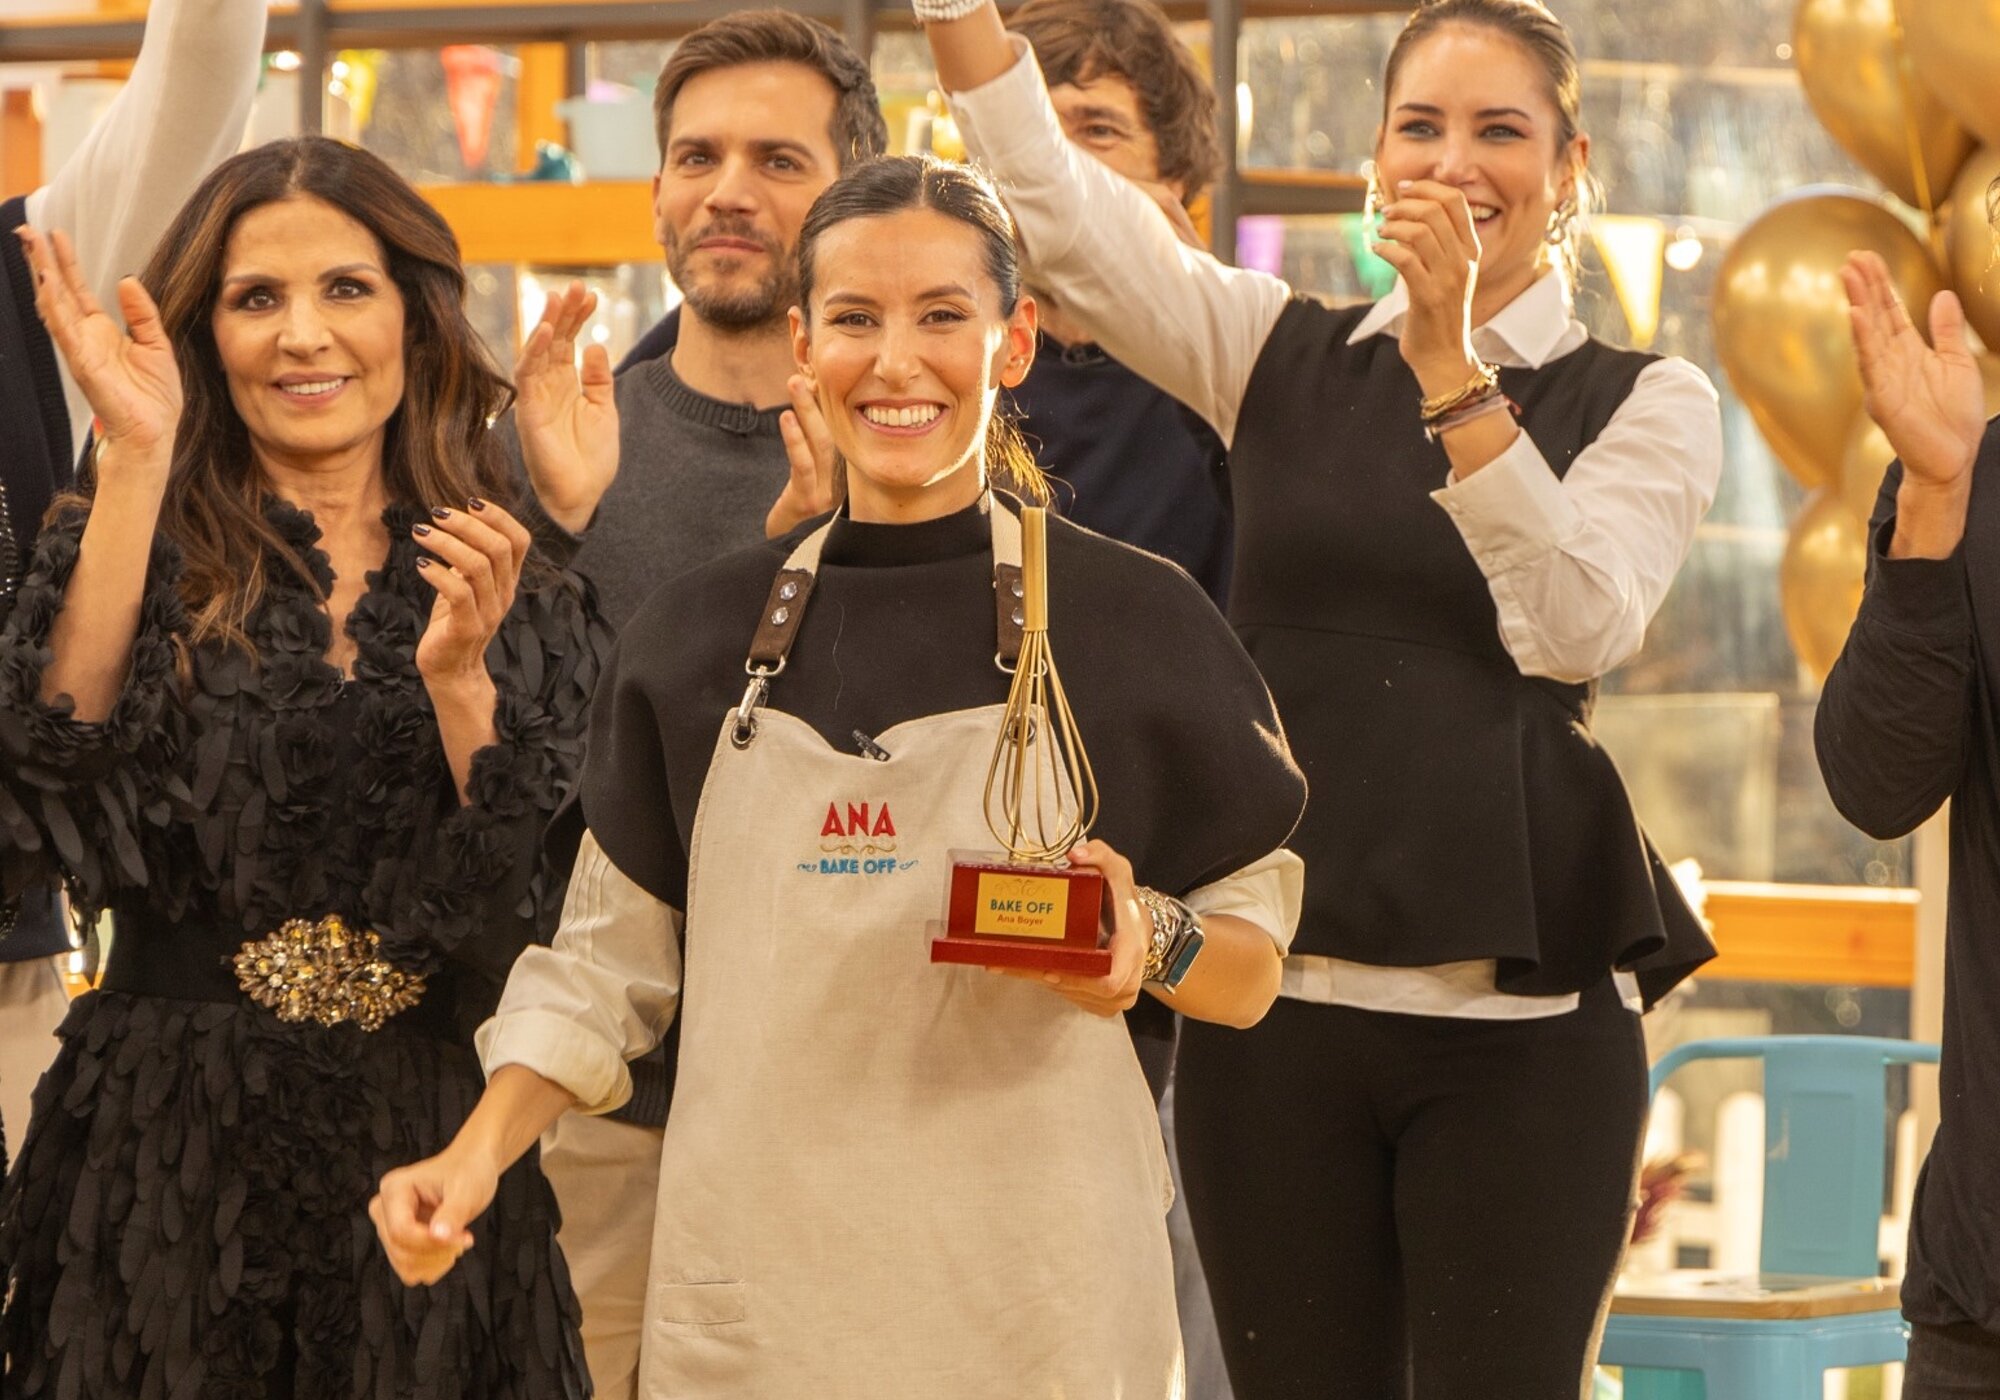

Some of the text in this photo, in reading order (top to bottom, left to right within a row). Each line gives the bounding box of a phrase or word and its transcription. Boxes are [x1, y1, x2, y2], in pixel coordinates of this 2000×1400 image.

[820, 801, 896, 836] ANA
[820, 858, 896, 874] BAKE OFF
[990, 899, 1054, 914] BAKE OFF
[997, 914, 1043, 927] Ana Boyer
